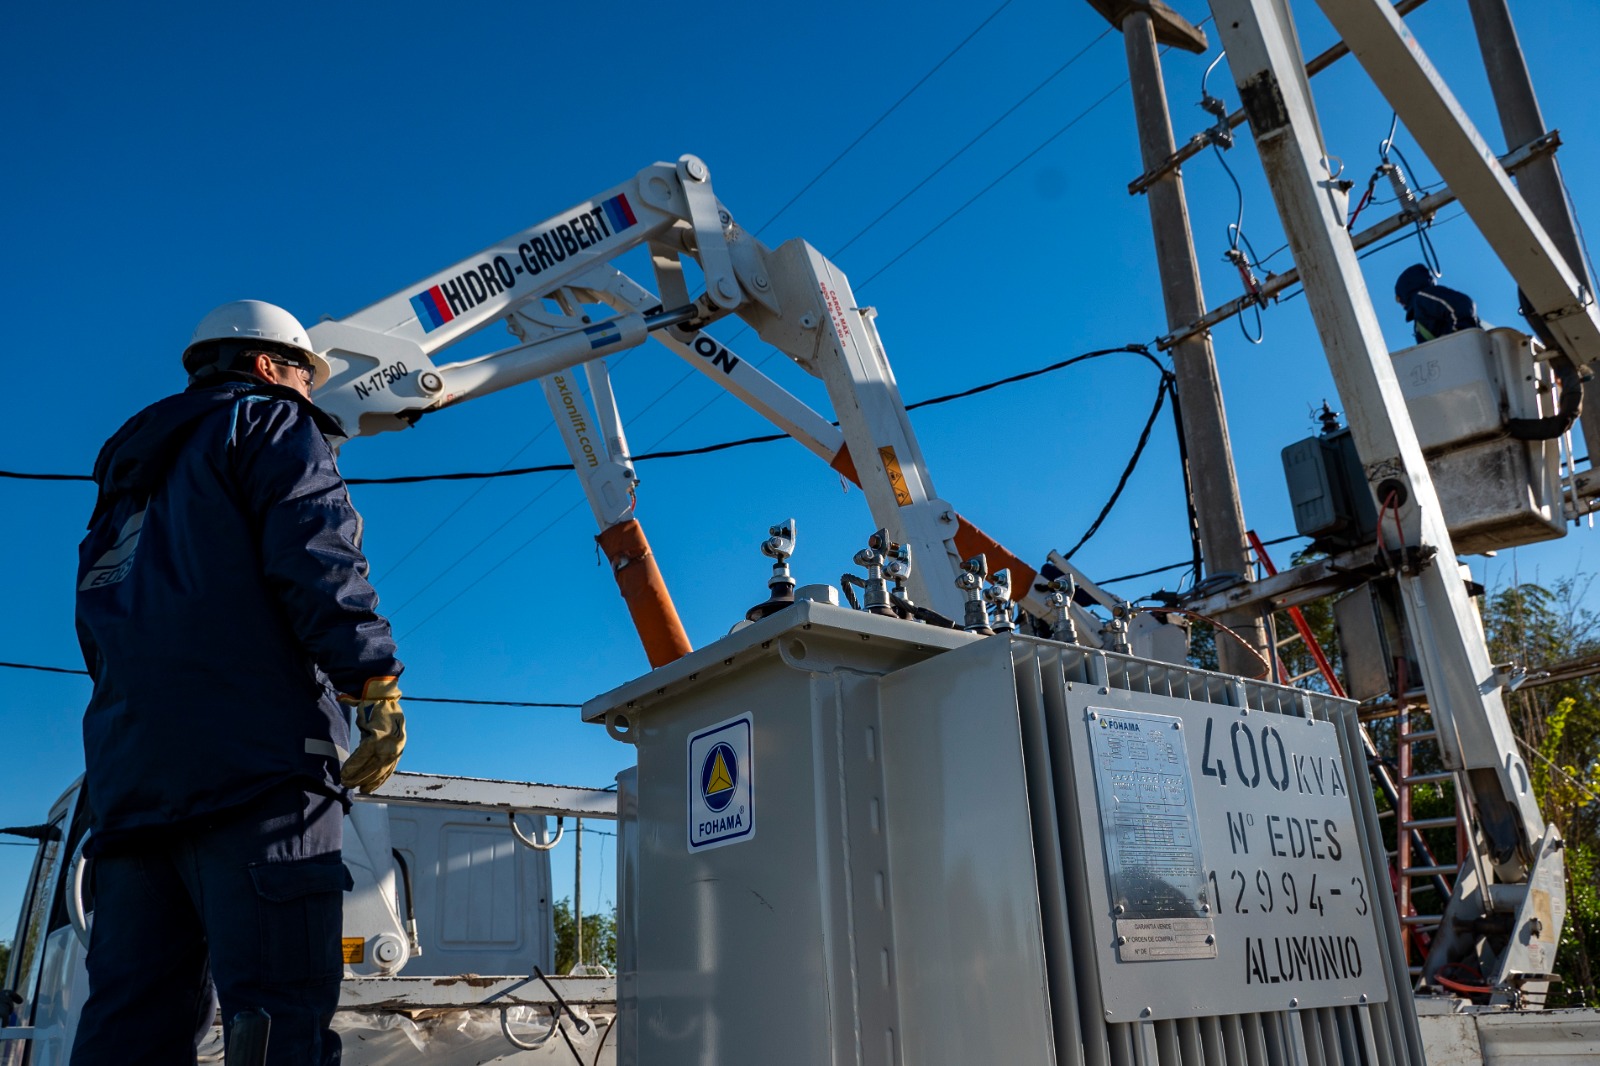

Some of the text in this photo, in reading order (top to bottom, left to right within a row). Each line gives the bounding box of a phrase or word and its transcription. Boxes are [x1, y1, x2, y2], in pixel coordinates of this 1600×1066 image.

[441, 206, 611, 316] HIDRO-GRUBERT
[830, 290, 842, 316] CARGA
[353, 361, 408, 400] N-17500
[554, 375, 599, 467] axionlift.com
[1108, 720, 1141, 732] FOHAMA
[1202, 717, 1289, 792] 400
[1292, 752, 1347, 798] KVA
[699, 813, 743, 837] FOHAMA
[1266, 815, 1342, 861] EDES
[1208, 869, 1367, 916] 12994-3
[1246, 936, 1362, 984] ALUMINIO
